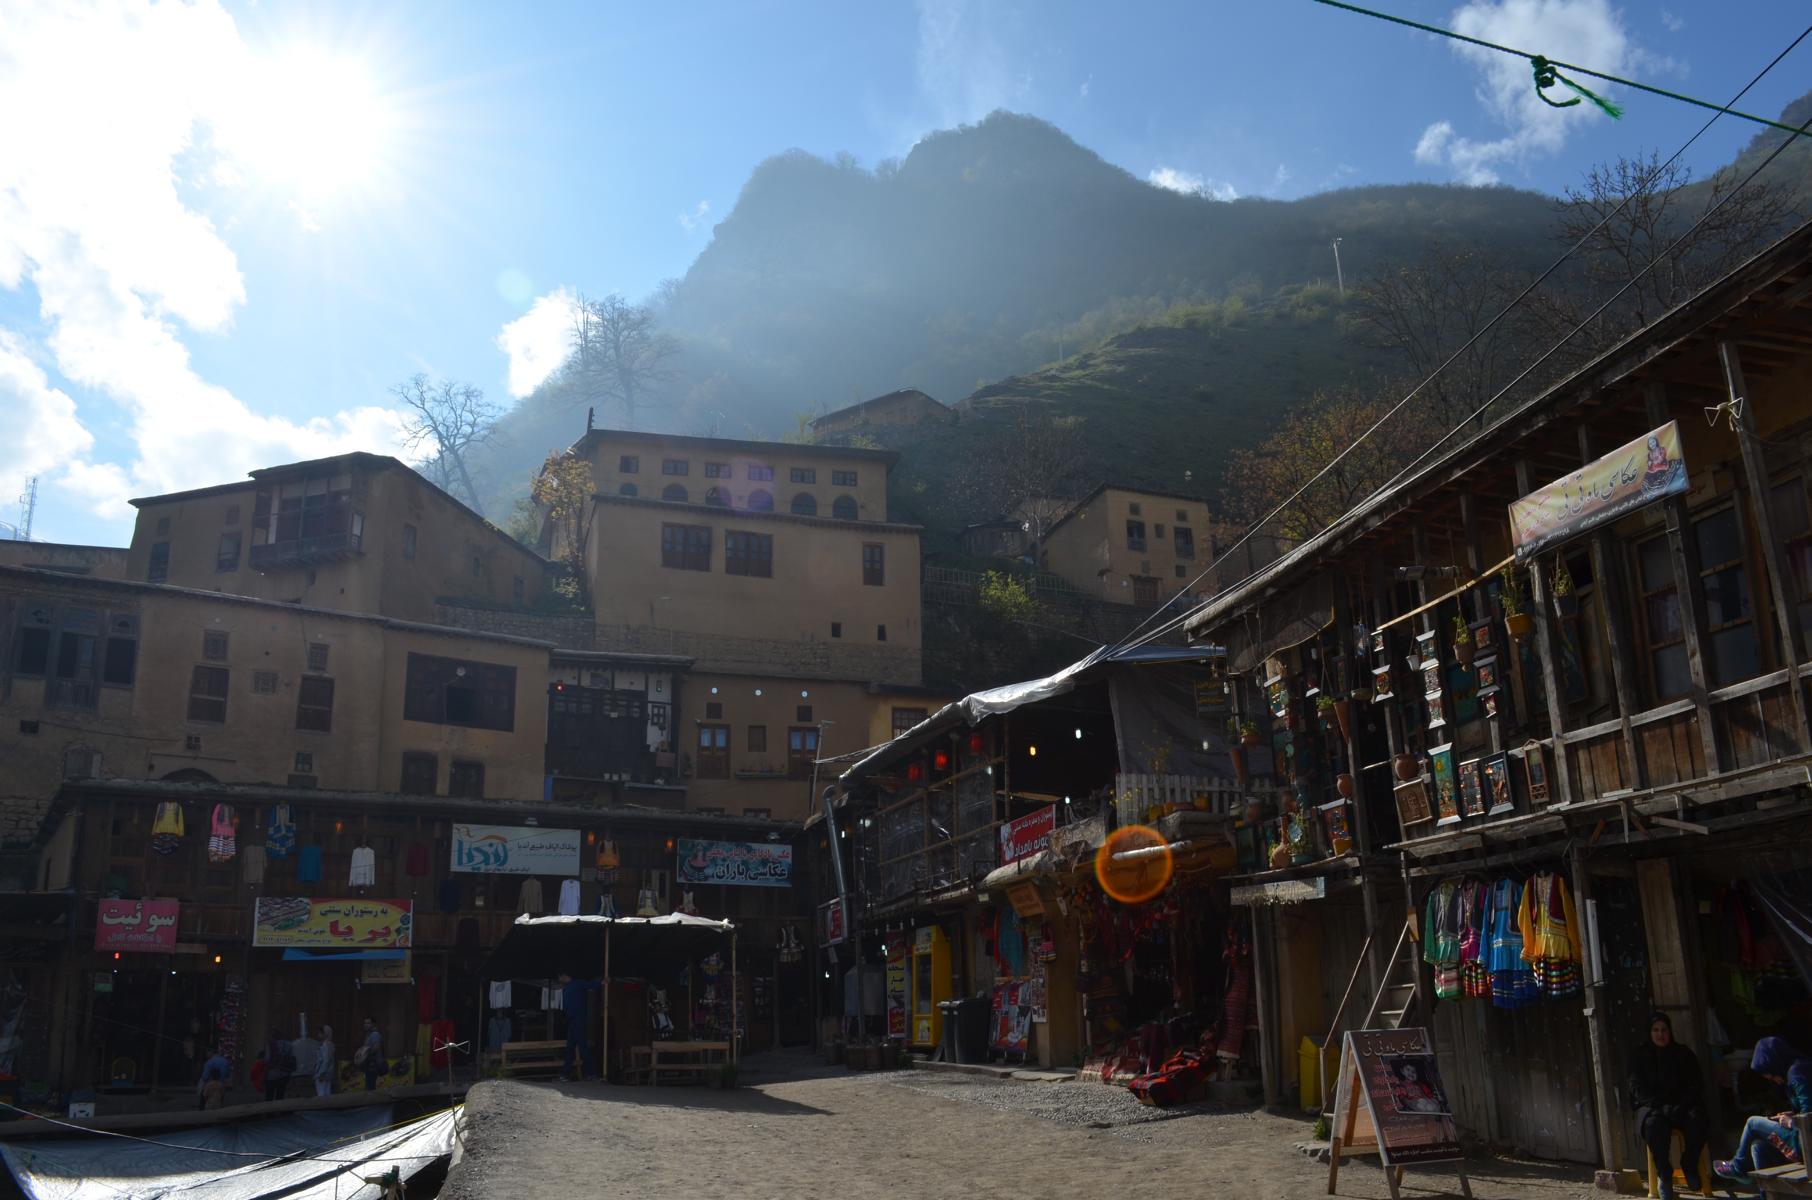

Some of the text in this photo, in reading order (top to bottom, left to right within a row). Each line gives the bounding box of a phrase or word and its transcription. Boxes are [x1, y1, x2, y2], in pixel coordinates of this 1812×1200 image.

[1601, 455, 1639, 502] عکاسی
[714, 863, 788, 880] عکاسی باران
[102, 902, 175, 932] سوئیت
[344, 905, 378, 917] رستوران
